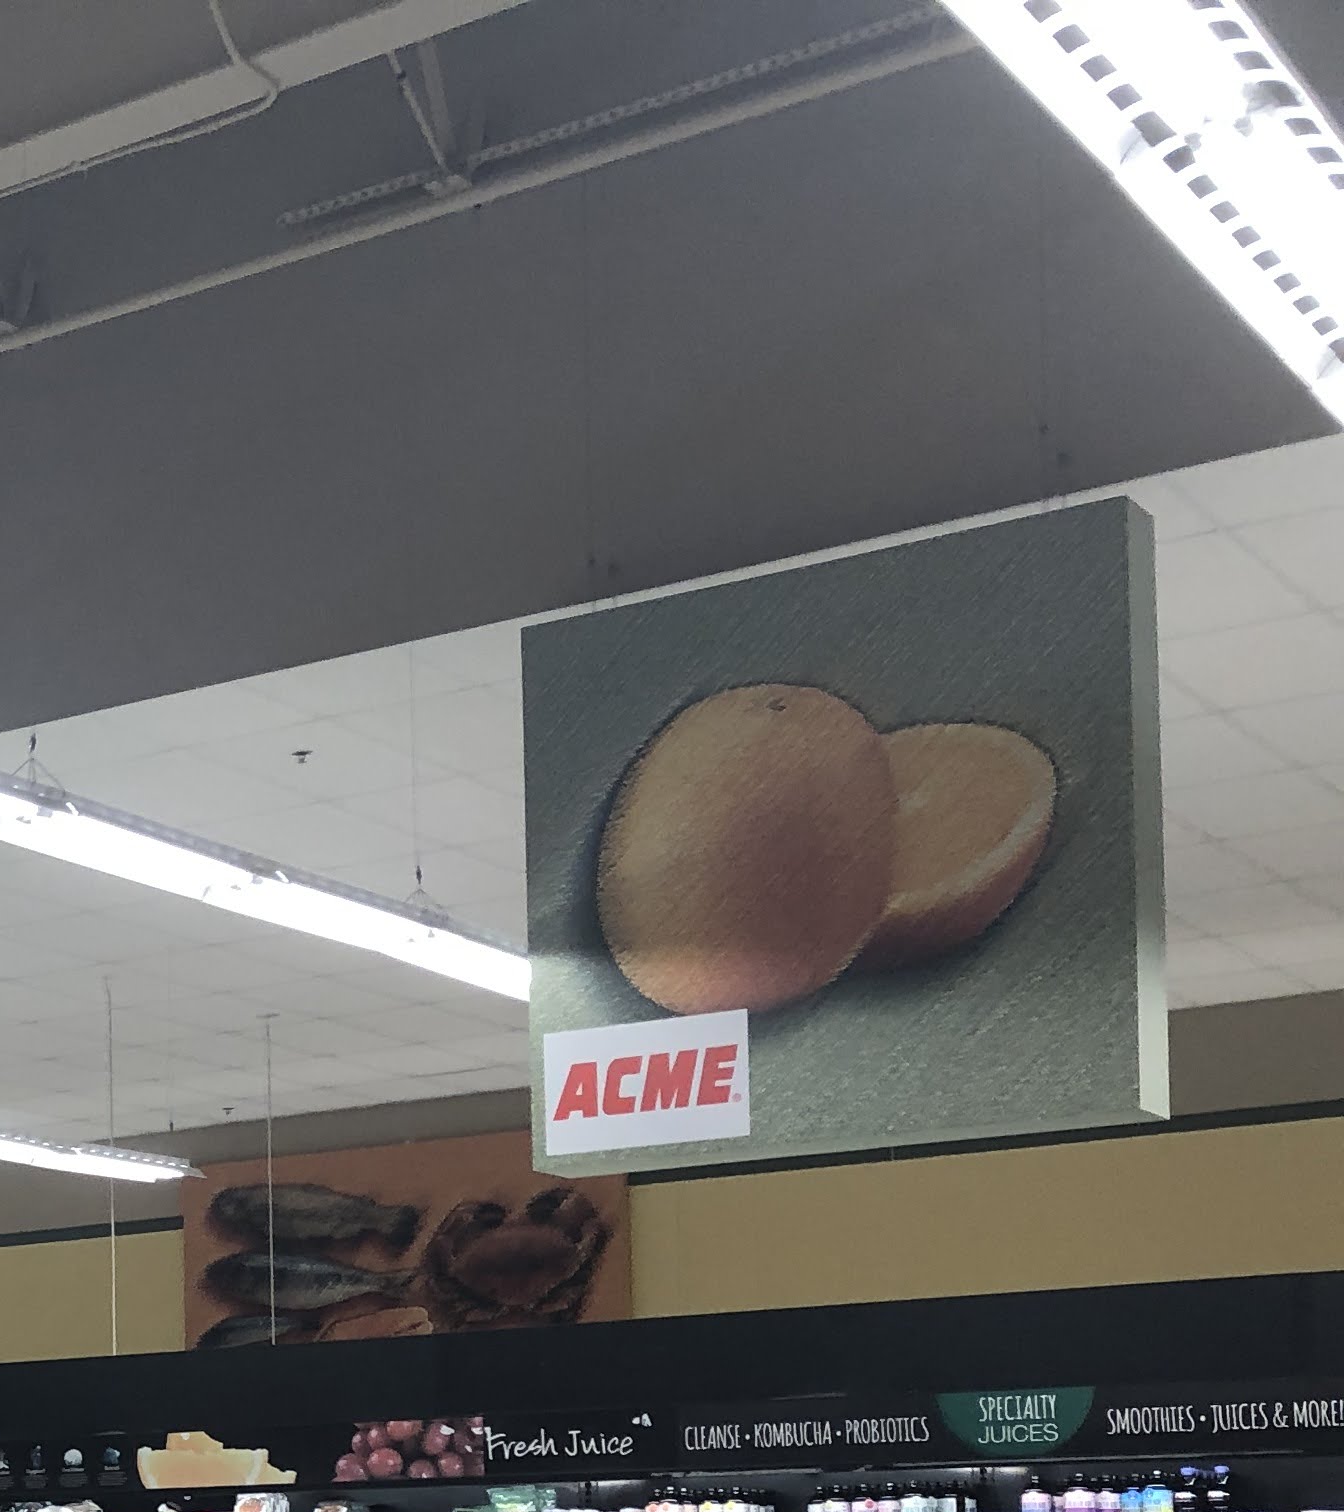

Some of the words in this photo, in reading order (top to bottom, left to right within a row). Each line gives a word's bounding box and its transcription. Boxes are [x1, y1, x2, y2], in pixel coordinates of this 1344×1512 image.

[553, 1044, 739, 1121] ACME
[978, 1394, 1057, 1422] SPECIALTY
[1106, 1405, 1194, 1435] SMOOTHIES
[1210, 1401, 1268, 1433] JUICES
[1272, 1403, 1289, 1429] &
[485, 1427, 555, 1460] Fresh
[563, 1430, 634, 1457] Juice
[684, 1425, 742, 1451] CLEANSE
[753, 1420, 833, 1449] KOMBUCHA
[844, 1416, 930, 1444] PROBIOTICS
[977, 1423, 1059, 1444] JUICES
